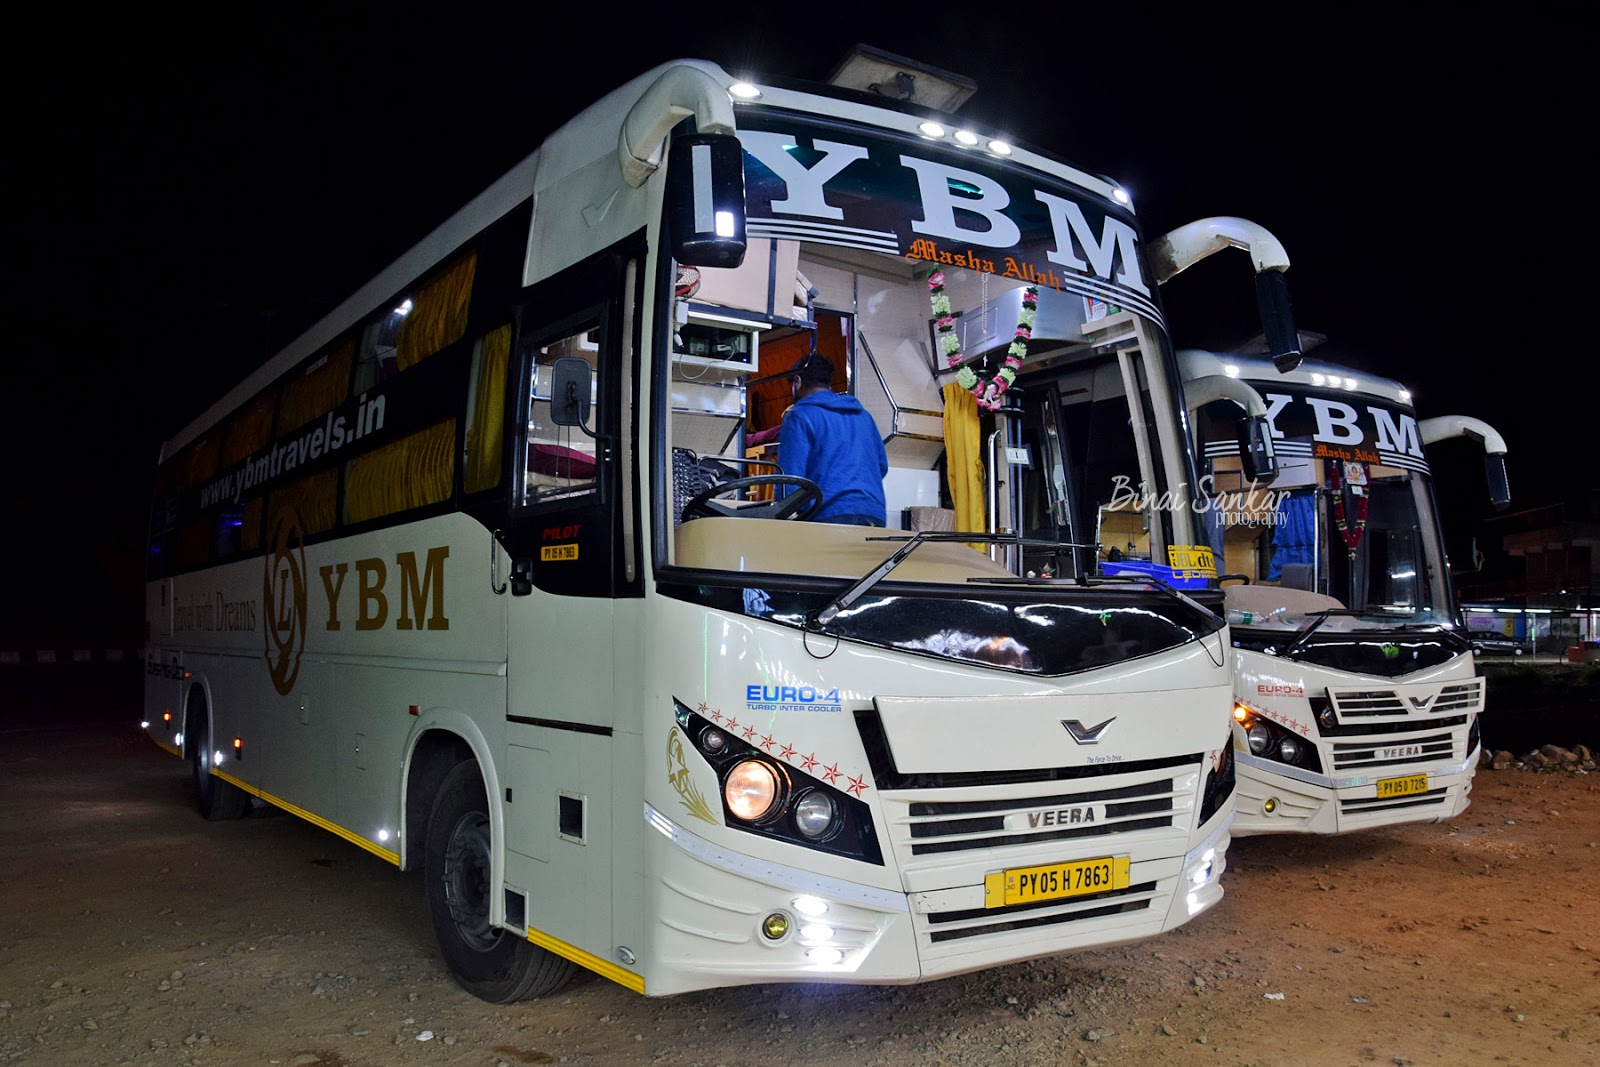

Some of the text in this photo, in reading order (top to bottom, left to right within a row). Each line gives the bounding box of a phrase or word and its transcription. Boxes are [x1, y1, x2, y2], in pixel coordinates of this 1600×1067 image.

[735, 129, 1152, 299] YBM
[905, 238, 1062, 293] Masha Allah
[1262, 393, 1425, 460] YBM
[200, 392, 386, 510] www.ybmtravels.in
[1315, 445, 1380, 465] Masha Allah
[543, 525, 582, 540] PILOT
[544, 548, 551, 559] PY
[563, 546, 575, 558] 7863
[319, 546, 449, 631] YBM
[216, 591, 256, 632] Dreams
[747, 685, 841, 703] EURO-4
[1257, 684, 1303, 694] EURO-4
[747, 703, 776, 711] TURBO
[1384, 745, 1419, 758] VEERA
[1027, 807, 1095, 828] VEERA
[1019, 871, 1058, 896] PY05
[1062, 869, 1071, 891] H
[1076, 864, 1109, 889] 7863
